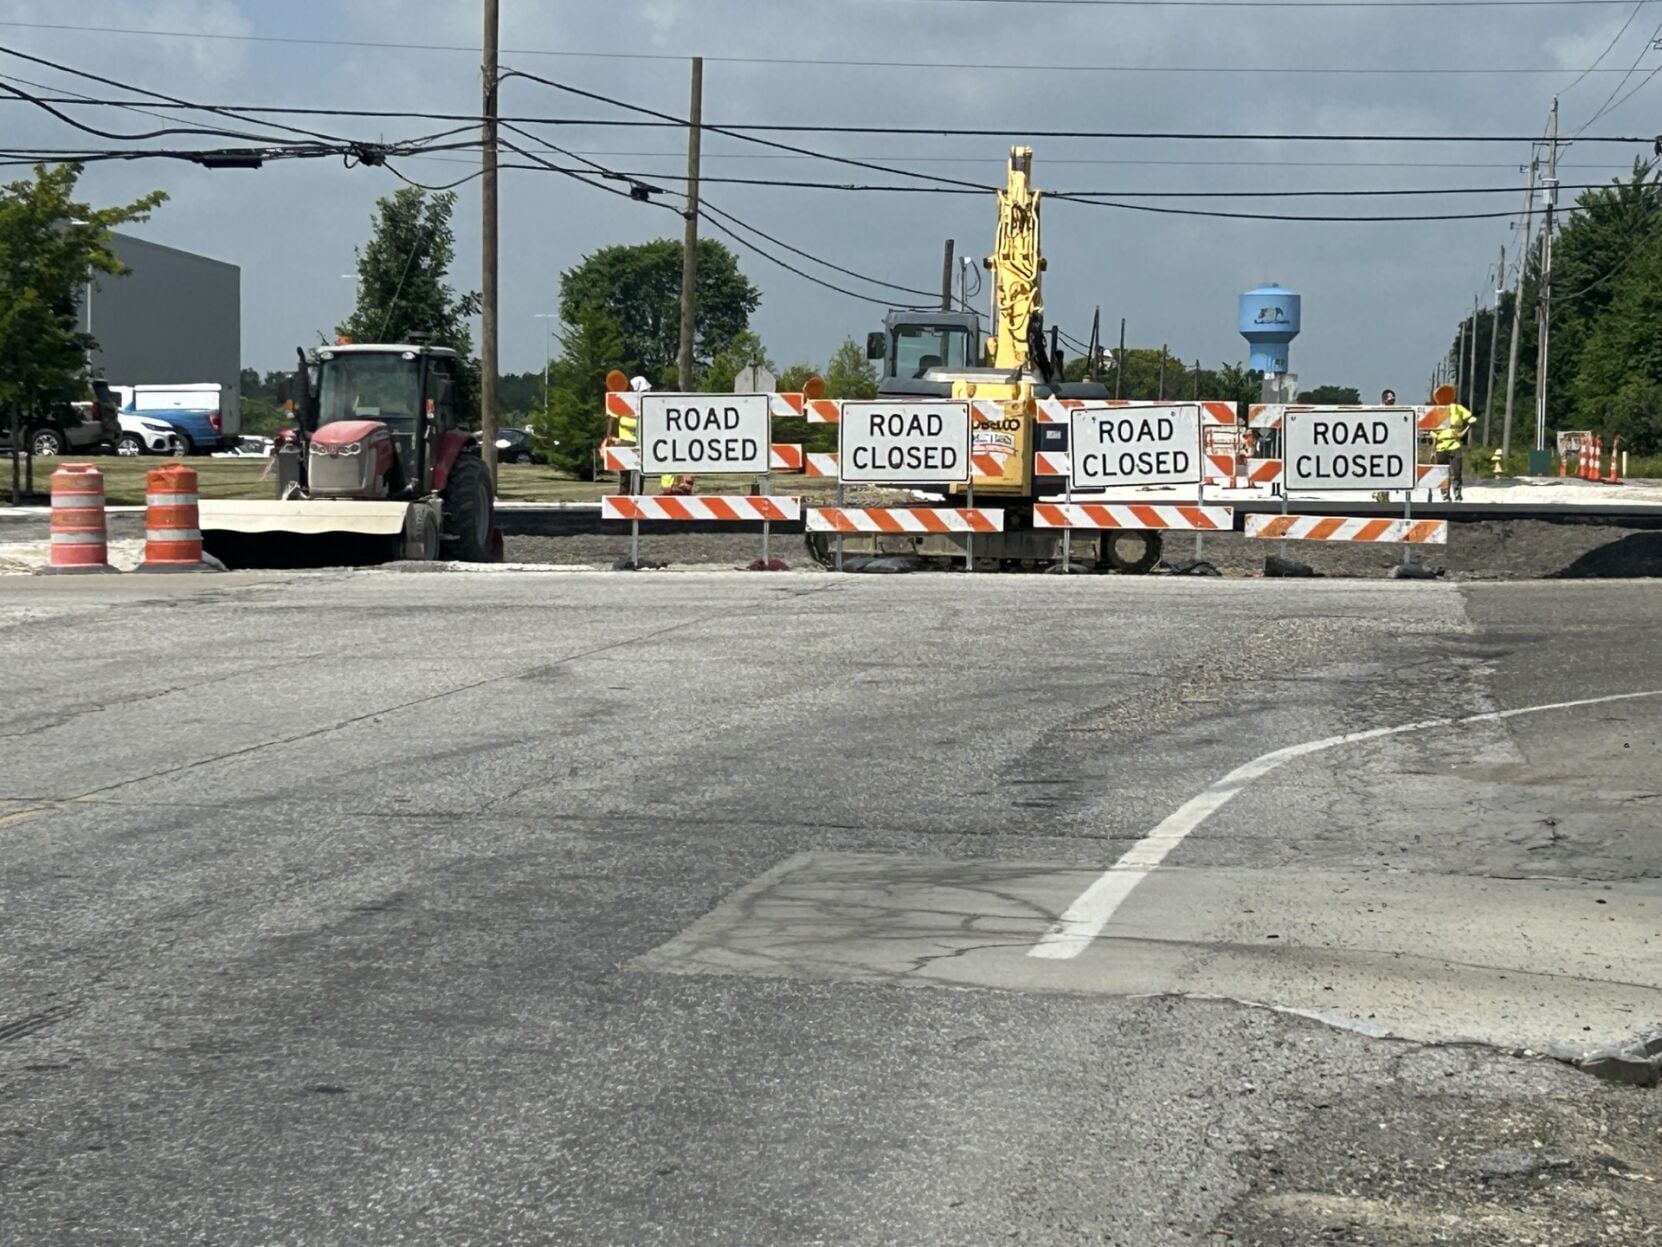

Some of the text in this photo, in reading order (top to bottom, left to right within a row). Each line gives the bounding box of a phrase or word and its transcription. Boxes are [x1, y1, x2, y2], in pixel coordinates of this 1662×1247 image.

[666, 407, 740, 431] ROAD
[869, 413, 943, 437] ROAD
[1099, 418, 1174, 444] ROAD
[1313, 421, 1389, 446] ROAD
[652, 438, 758, 463] CLOSED
[852, 446, 957, 470] CLOSED
[1082, 450, 1189, 478] CLOSED
[1296, 454, 1404, 479] CLOSED
